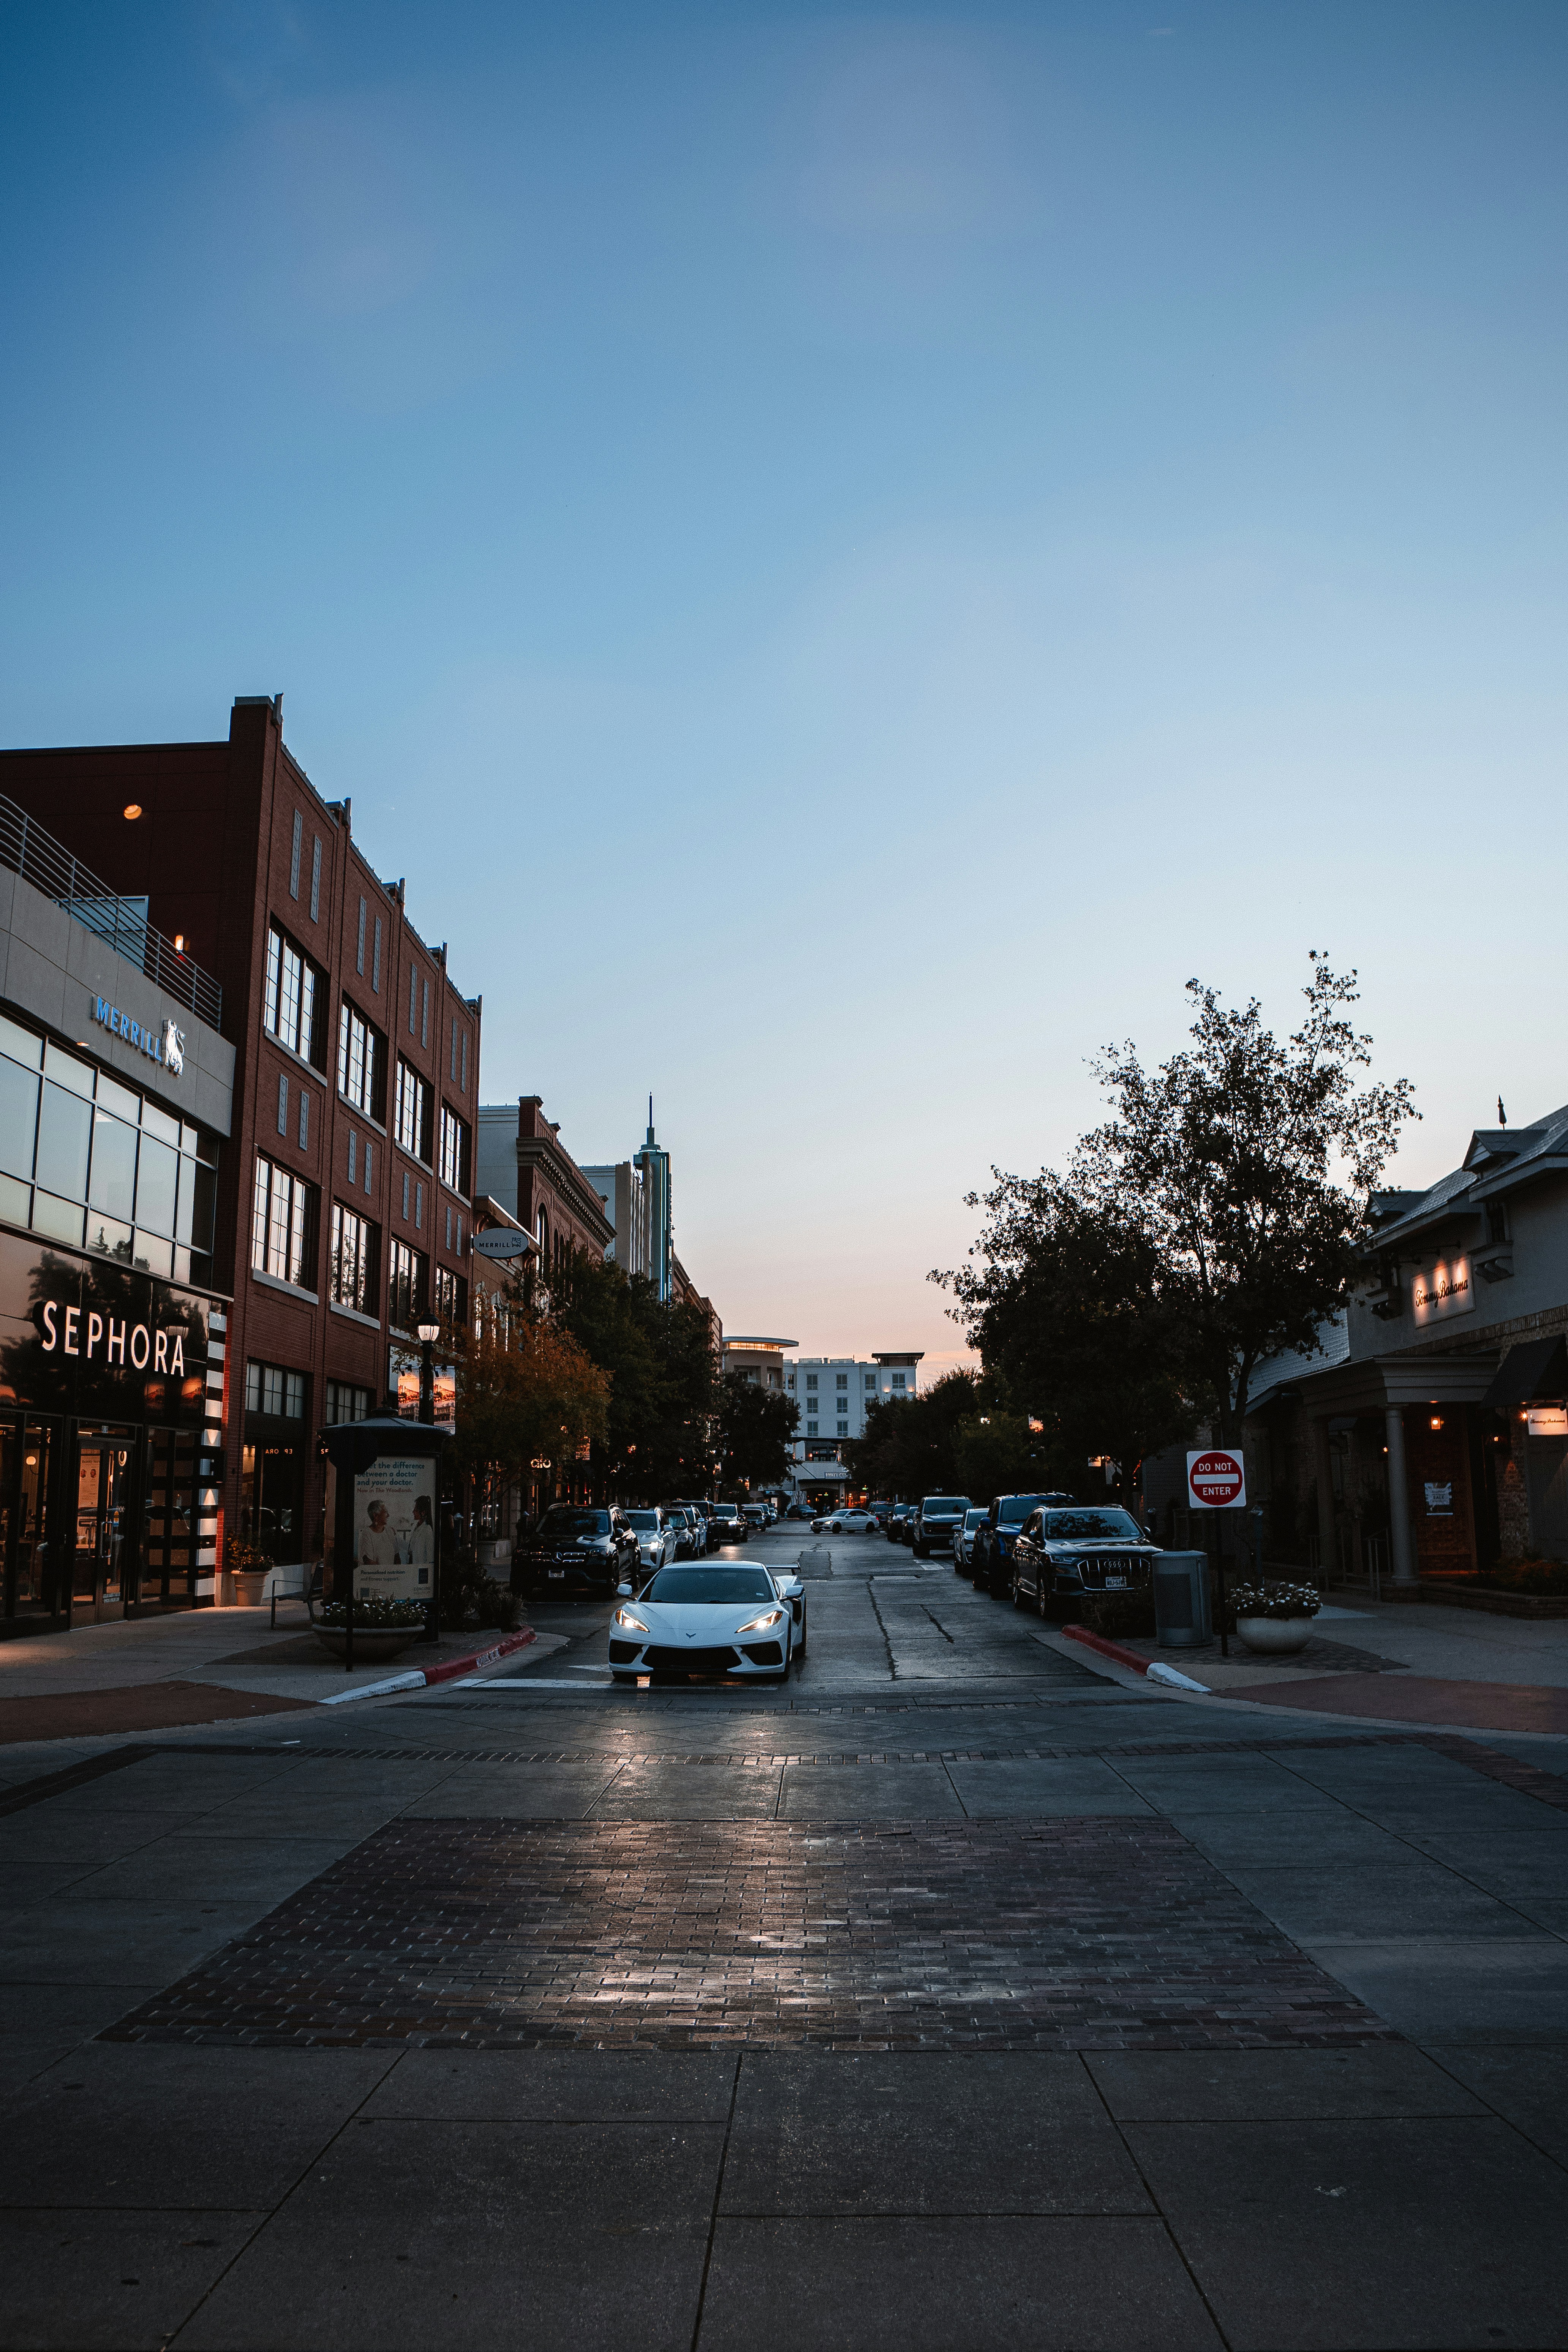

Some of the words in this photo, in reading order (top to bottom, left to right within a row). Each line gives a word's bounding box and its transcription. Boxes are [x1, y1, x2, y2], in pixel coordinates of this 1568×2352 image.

[95, 996, 162, 1062] MERRILL
[1416, 1289, 1438, 1308] Tommy
[1438, 1279, 1468, 1299] Bahama
[42, 1301, 185, 1377] SEPHORA
[1199, 1463, 1211, 1472] DO
[1215, 1462, 1231, 1471] NOT
[1203, 1487, 1231, 1496] ENTER
